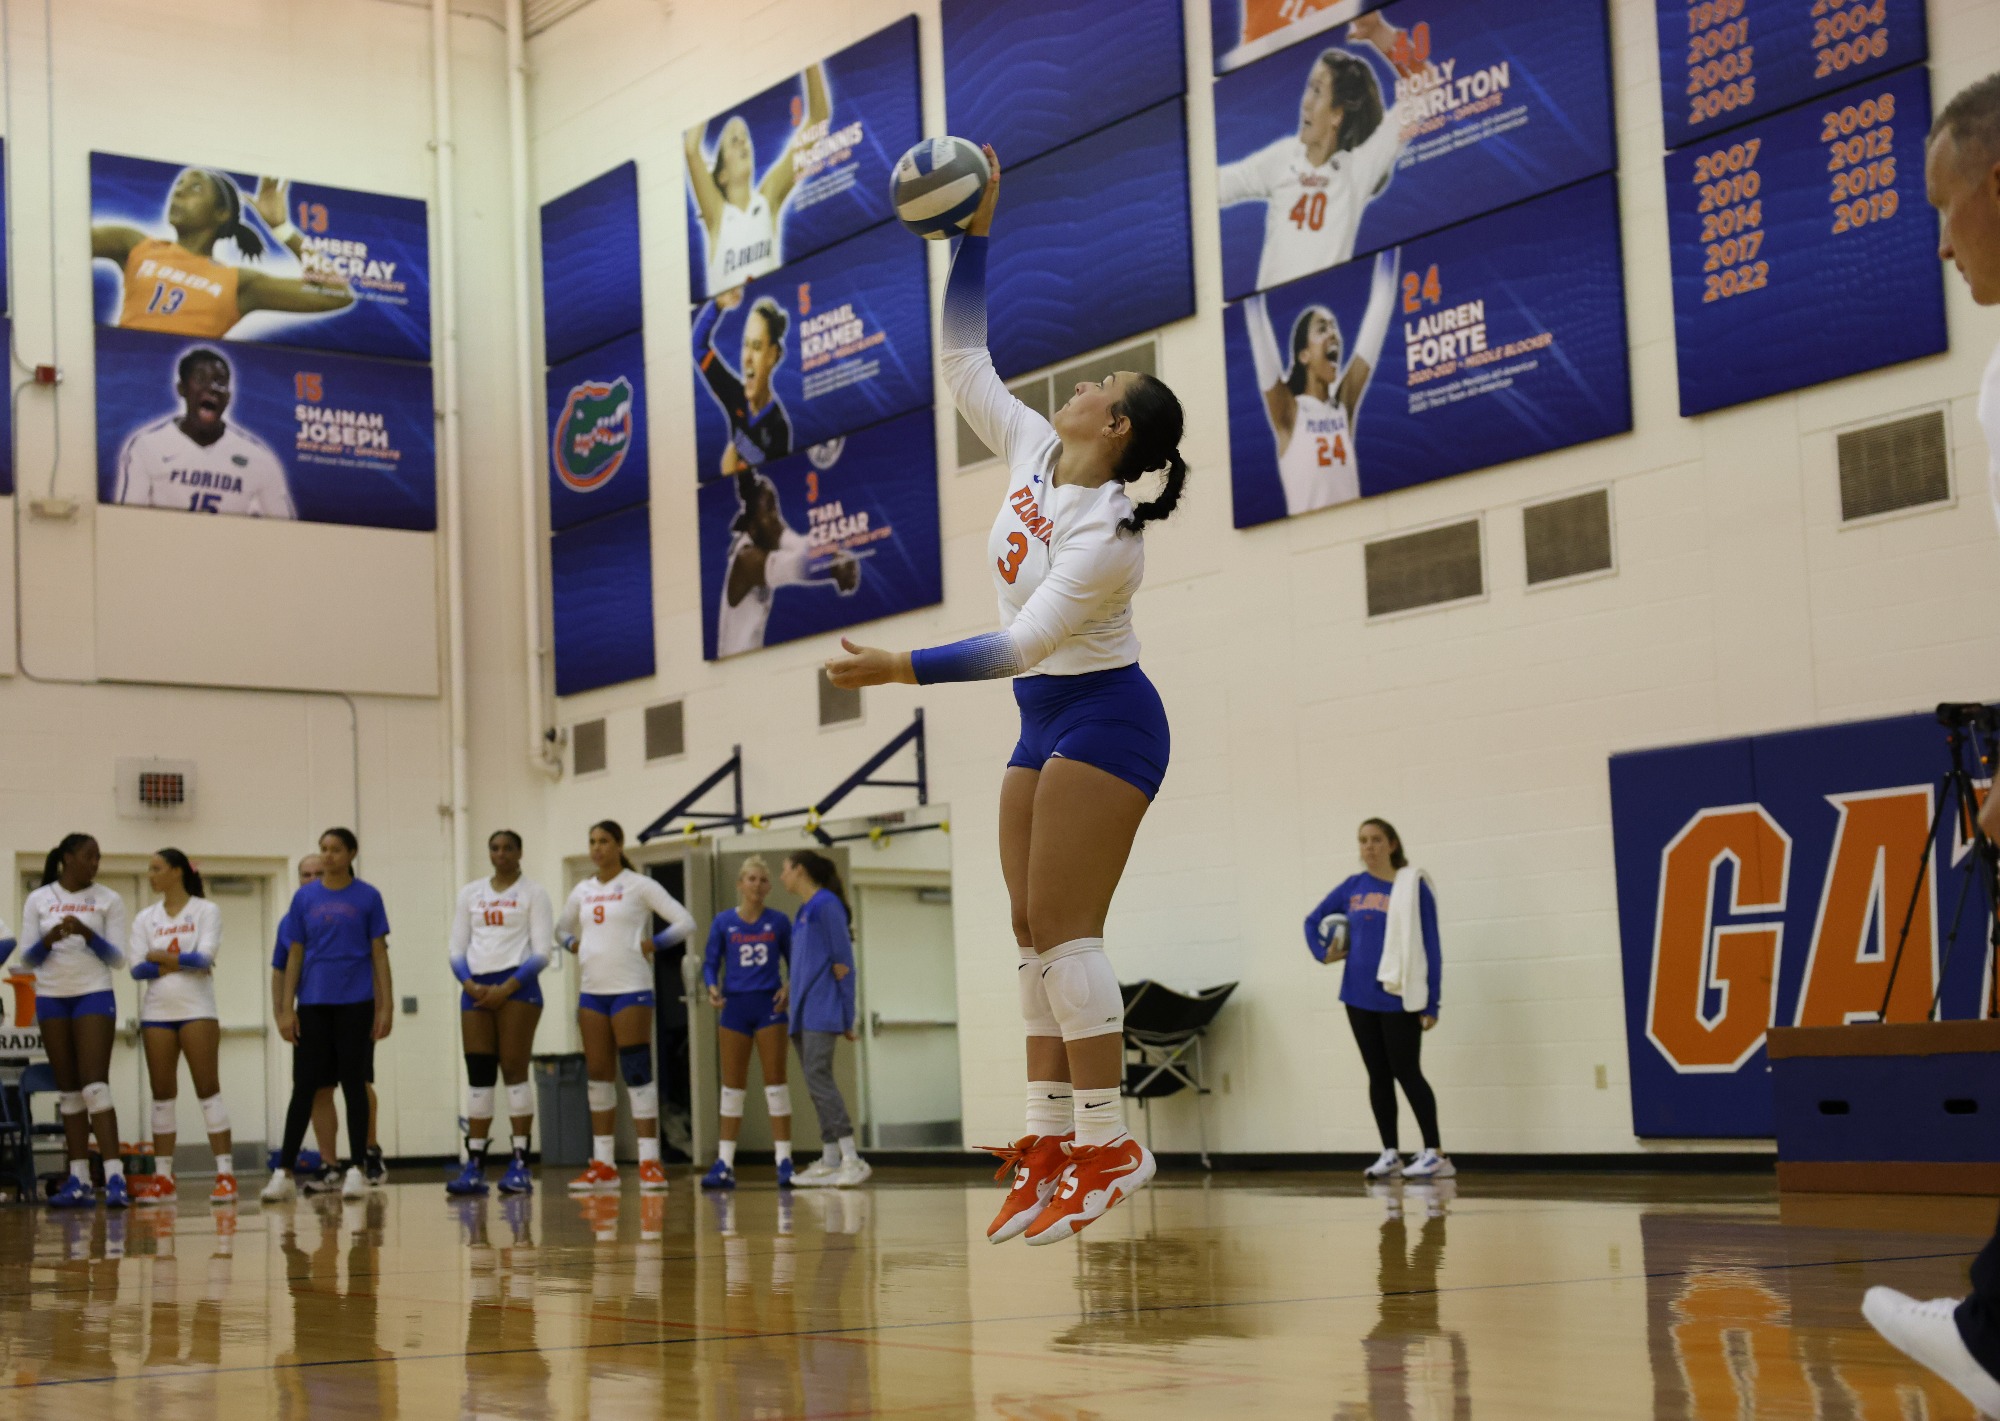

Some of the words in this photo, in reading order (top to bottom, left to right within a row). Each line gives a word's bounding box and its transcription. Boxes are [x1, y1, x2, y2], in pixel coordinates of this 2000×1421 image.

[1393, 21, 1431, 66] 40
[1687, 16, 1750, 65] 2001
[1812, 0, 1887, 48] 2004
[1686, 45, 1754, 95] 2003
[1814, 27, 1889, 79] 2006
[1395, 57, 1456, 99] HOLLY
[1400, 61, 1511, 126] CARLTON
[1688, 75, 1756, 125] 2005
[1820, 92, 1895, 142] 2008
[1692, 137, 1761, 184] 2007
[1827, 125, 1894, 172] 2012
[1697, 169, 1761, 213] 2010
[1829, 156, 1896, 204] 2016
[298, 201, 329, 234] 13
[1288, 190, 1328, 232] 40
[1700, 199, 1762, 243] 2014
[1832, 188, 1899, 235] 2019
[300, 235, 368, 259] AMBER
[301, 251, 397, 281] McCRAY
[1703, 229, 1765, 272] 2017
[146, 281, 186, 315] 13
[798, 281, 811, 316] 5
[1402, 263, 1441, 314] 24
[1702, 260, 1770, 304] 2022
[1404, 299, 1485, 344] LAUREN
[1406, 323, 1488, 373] FORTE
[294, 371, 324, 402] 15
[295, 403, 385, 431] SHAINAH
[296, 421, 389, 451] JOSEPH
[1316, 434, 1346, 467] 24
[169, 469, 244, 494] FLORIDA
[187, 491, 223, 514] 15
[805, 470, 819, 505] 3
[807, 511, 870, 548] CEASAR
[997, 532, 1029, 585] 3
[484, 910, 504, 926] 10
[593, 905, 605, 924] 9
[167, 937, 181, 954] 4
[739, 942, 769, 967] 23
